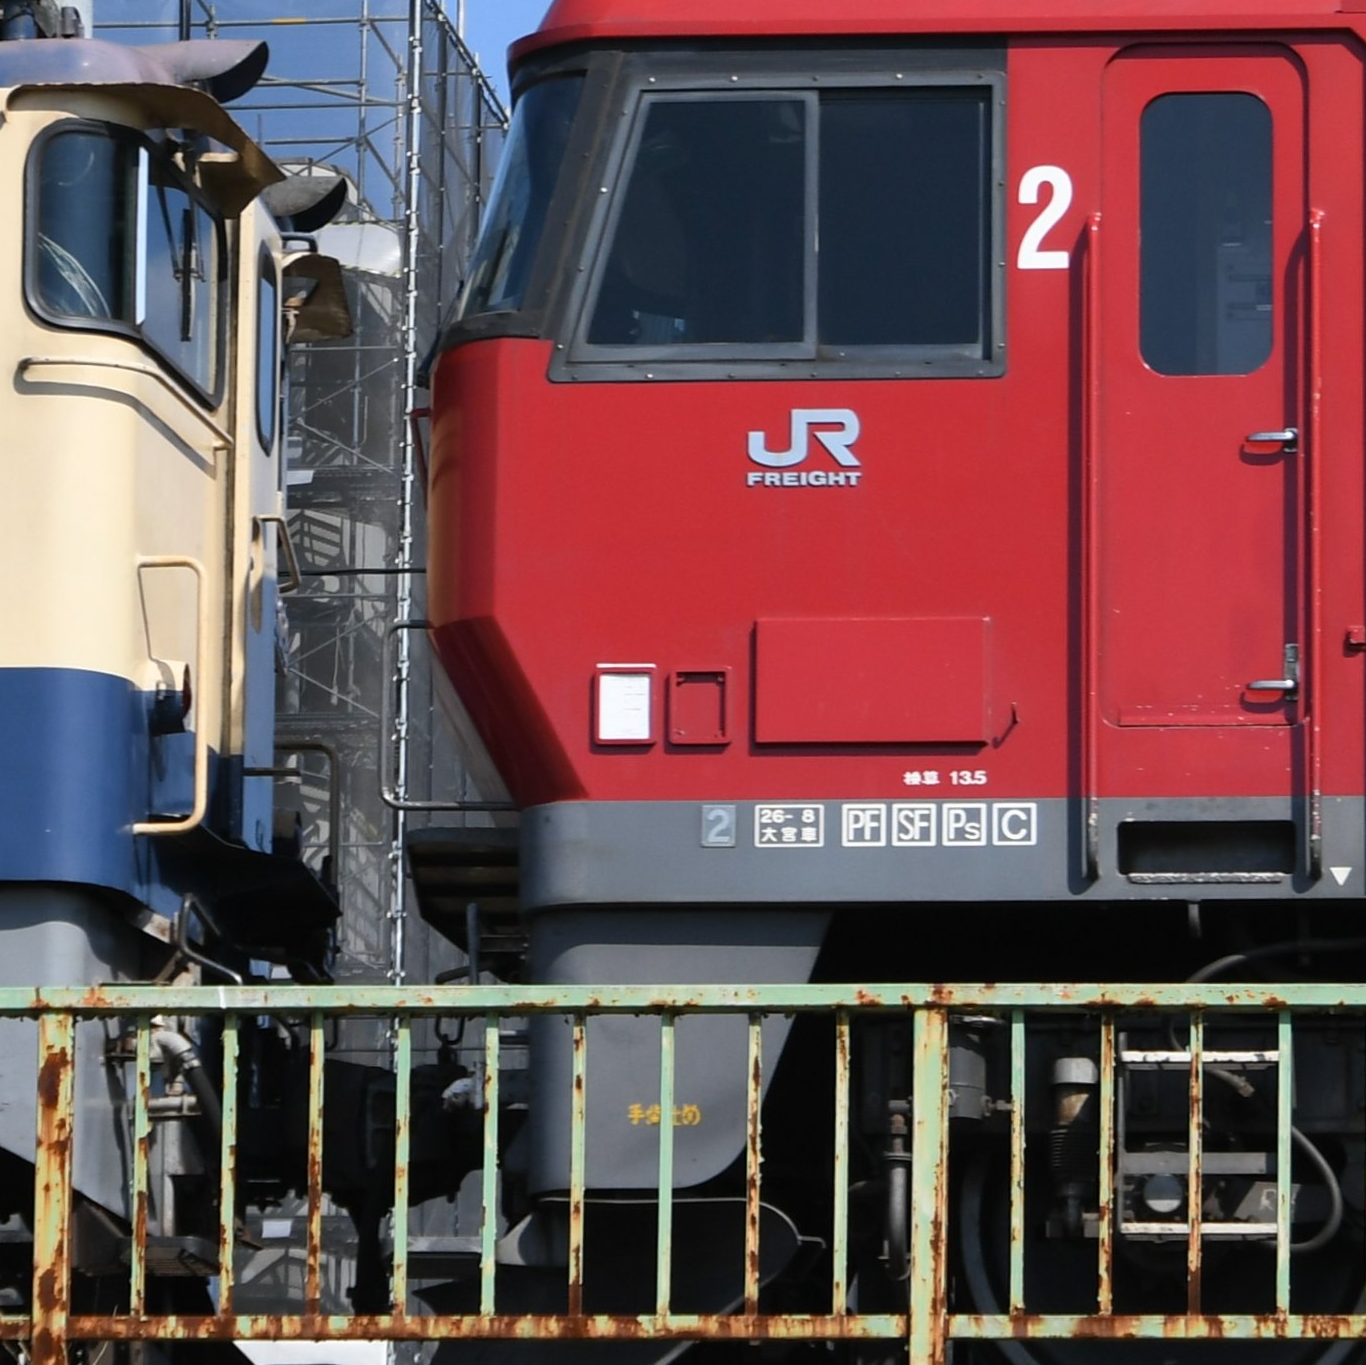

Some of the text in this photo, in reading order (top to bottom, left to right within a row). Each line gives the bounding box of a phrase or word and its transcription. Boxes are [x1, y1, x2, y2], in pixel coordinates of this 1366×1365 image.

[1016, 165, 1073, 270] 2
[747, 408, 862, 467] JR
[746, 470, 863, 487] FREIGHT
[949, 770, 988, 786] 13.5
[706, 809, 732, 843] 2
[848, 809, 881, 841] PF
[898, 809, 930, 841] SF
[1001, 809, 1029, 841] C
